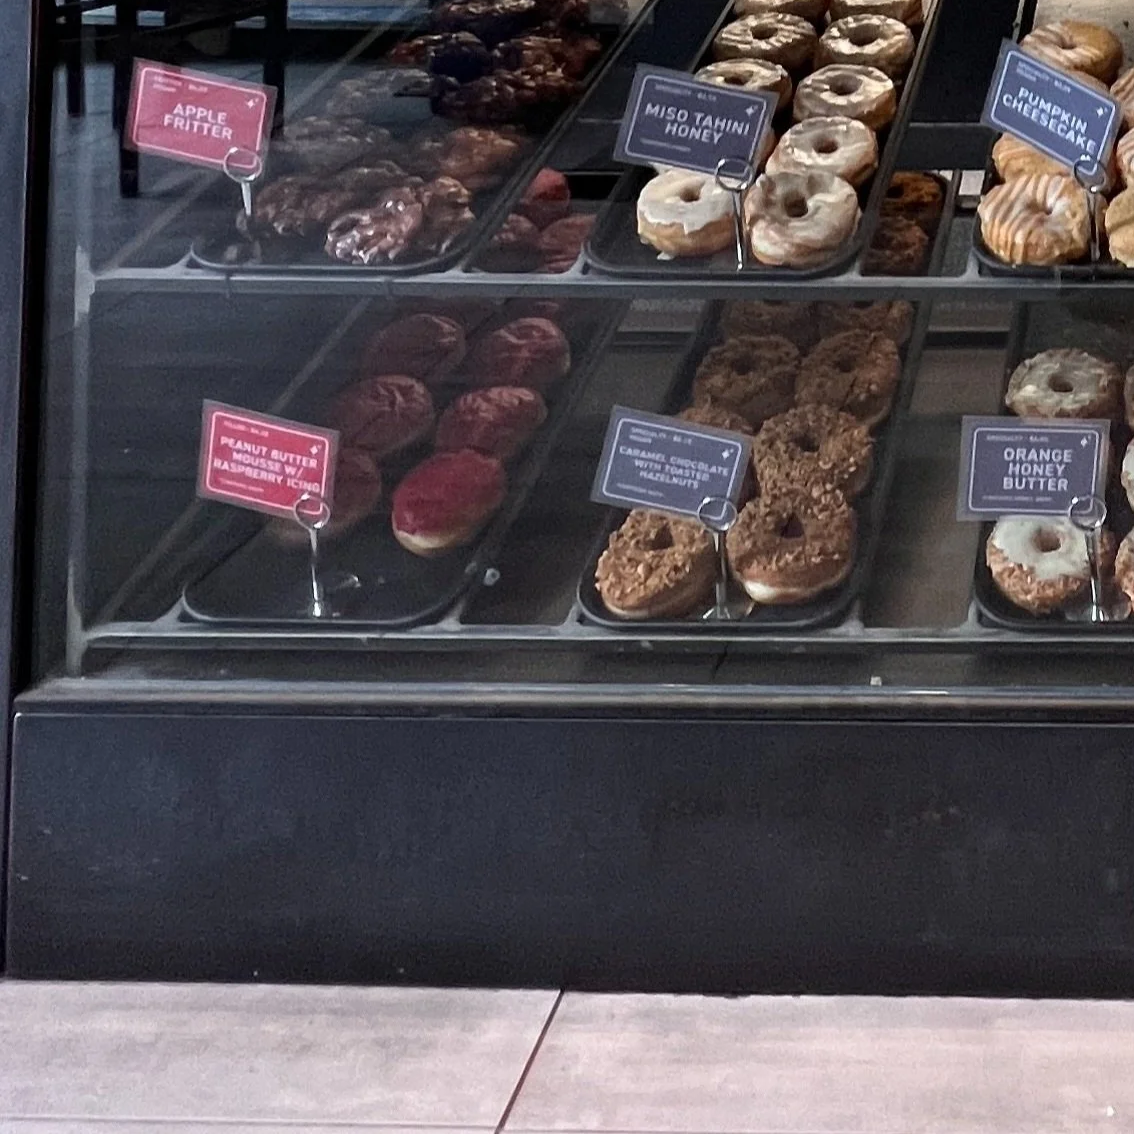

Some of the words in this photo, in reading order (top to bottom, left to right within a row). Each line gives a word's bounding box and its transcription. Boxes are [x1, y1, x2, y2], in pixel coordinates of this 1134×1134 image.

[172, 103, 228, 126] APPLE
[645, 102, 689, 122] MISO
[694, 112, 750, 136] TAHINI
[1018, 87, 1088, 134] PUMPKIN
[163, 114, 233, 140] FRITTER
[665, 122, 723, 145] HONEY
[1002, 93, 1097, 155] CHEESECAKE
[220, 436, 267, 456] PEANUT
[270, 449, 318, 469] BUTTER
[232, 451, 284, 472] MOUSSE
[619, 445, 666, 462] CARAMEL
[670, 455, 729, 477] CHOCOLATE
[1003, 447, 1073, 463] ORANGE
[213, 458, 283, 484] RASPBERRY
[287, 478, 321, 493] ICING
[634, 459, 662, 472] WITH
[665, 465, 709, 482] TOASTED
[639, 470, 699, 490] HAZELNUTS
[1008, 462, 1066, 477] HONEY
[1003, 476, 1069, 491] BUTTER
